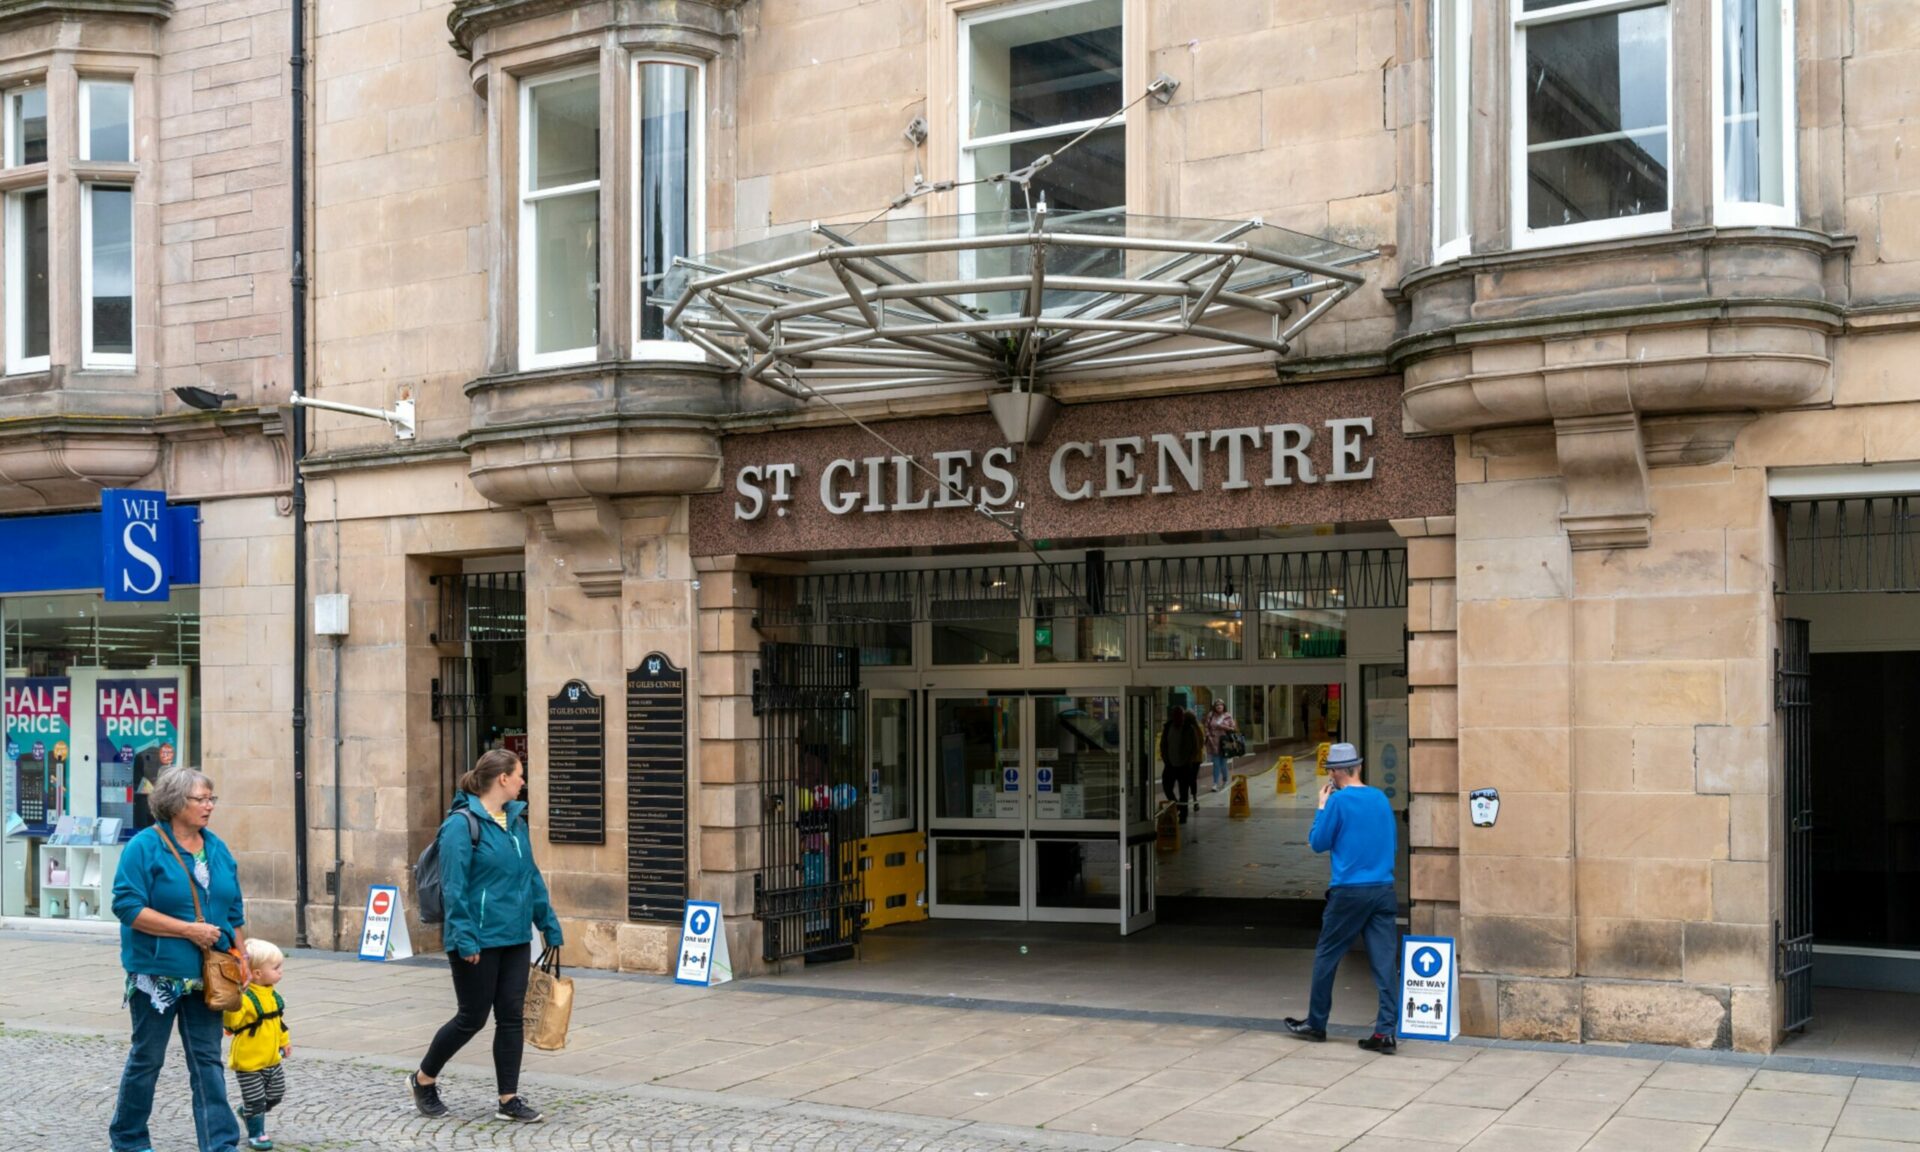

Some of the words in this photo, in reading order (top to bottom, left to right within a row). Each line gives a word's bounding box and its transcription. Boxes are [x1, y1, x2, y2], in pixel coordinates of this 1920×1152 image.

[819, 446, 1020, 515] GILES
[1048, 416, 1375, 500] CENTRE
[122, 498, 160, 520] WH
[123, 521, 162, 594] S
[655, 680, 681, 688] CENTRE
[99, 687, 175, 715] HALF
[6, 714, 61, 733] PRICE
[106, 716, 167, 736] PRICE
[1406, 979, 1424, 987] ONE
[1426, 980, 1446, 988] WAY
